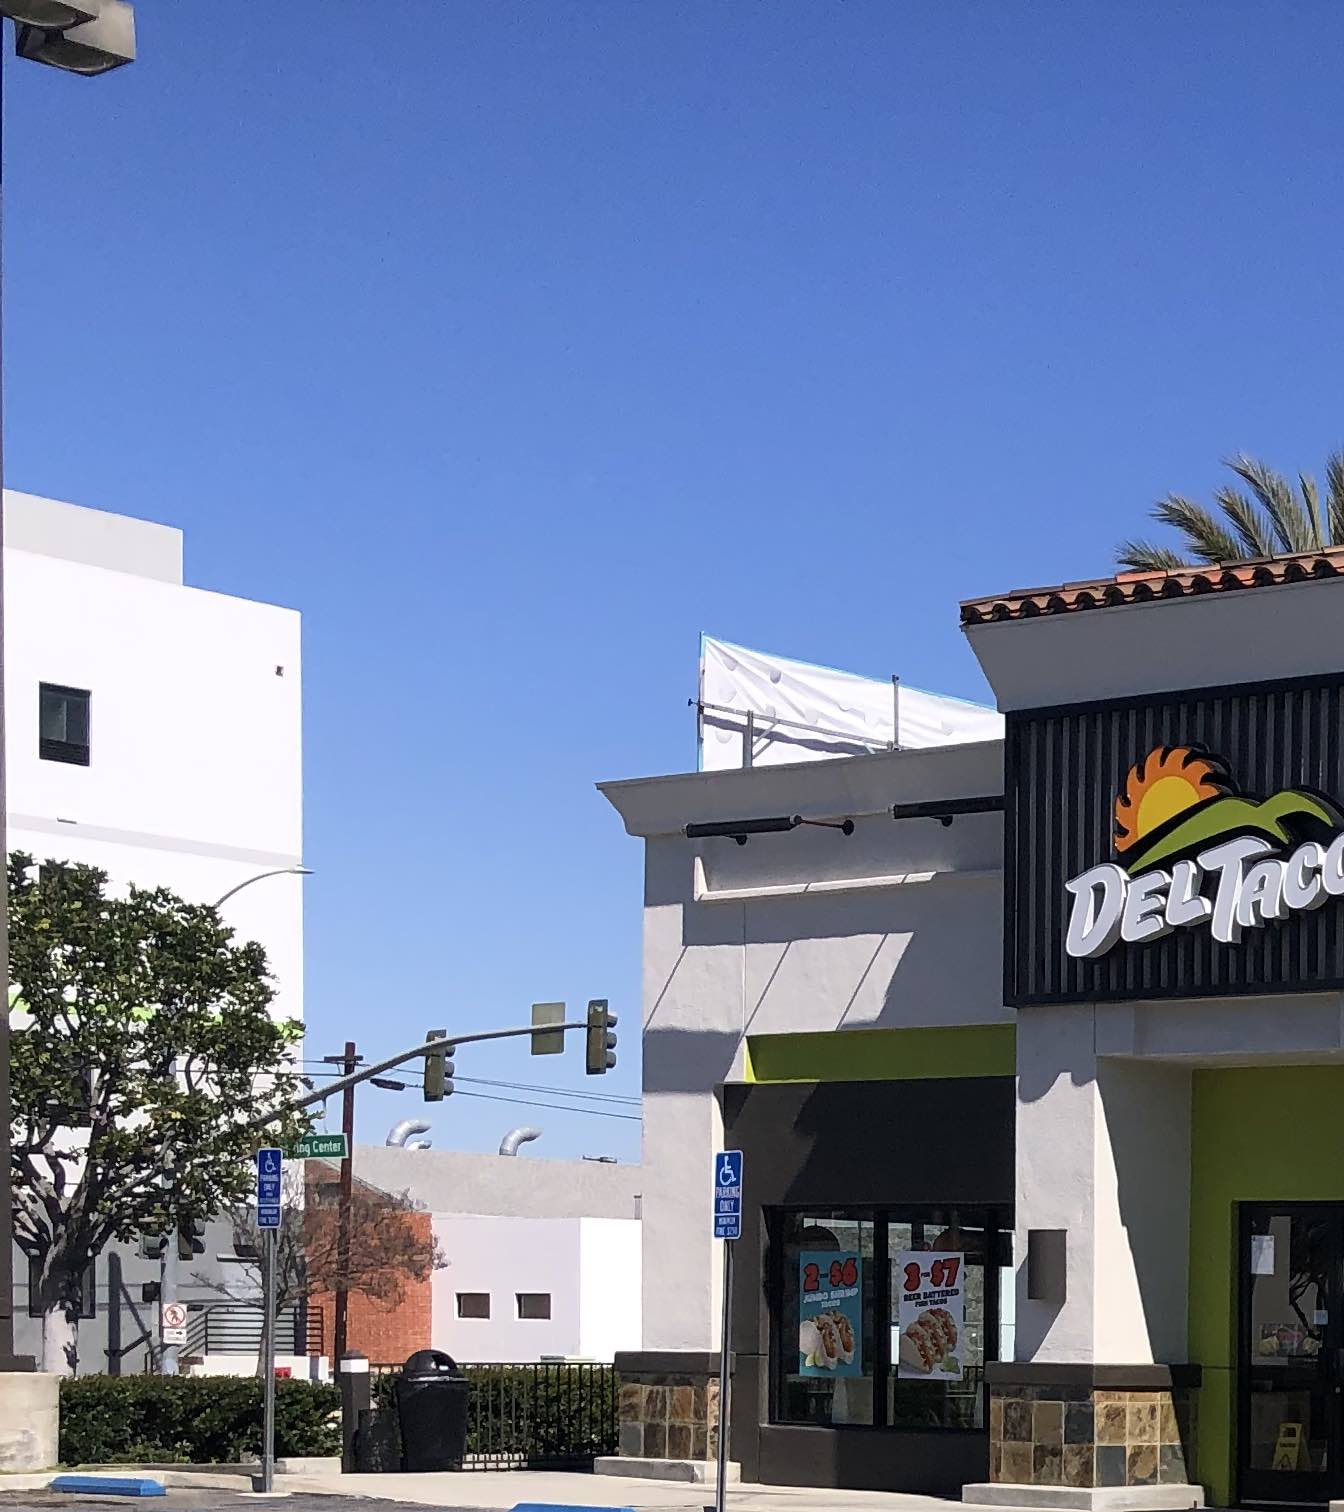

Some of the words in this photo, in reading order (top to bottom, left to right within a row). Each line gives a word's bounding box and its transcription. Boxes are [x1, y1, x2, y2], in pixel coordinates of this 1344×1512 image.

[1066, 860, 1212, 958] DEL
[313, 1141, 341, 1153] Center
[716, 1186, 740, 1198] PARKING
[720, 1200, 734, 1212] ONLY
[804, 1263, 820, 1292] 2
[829, 1258, 858, 1287] $6
[904, 1262, 921, 1292] 3
[930, 1257, 961, 1287] $7
[904, 1293, 922, 1302] BEER
[923, 1289, 959, 1300] BATTERED
[929, 1298, 948, 1306] TACOS
